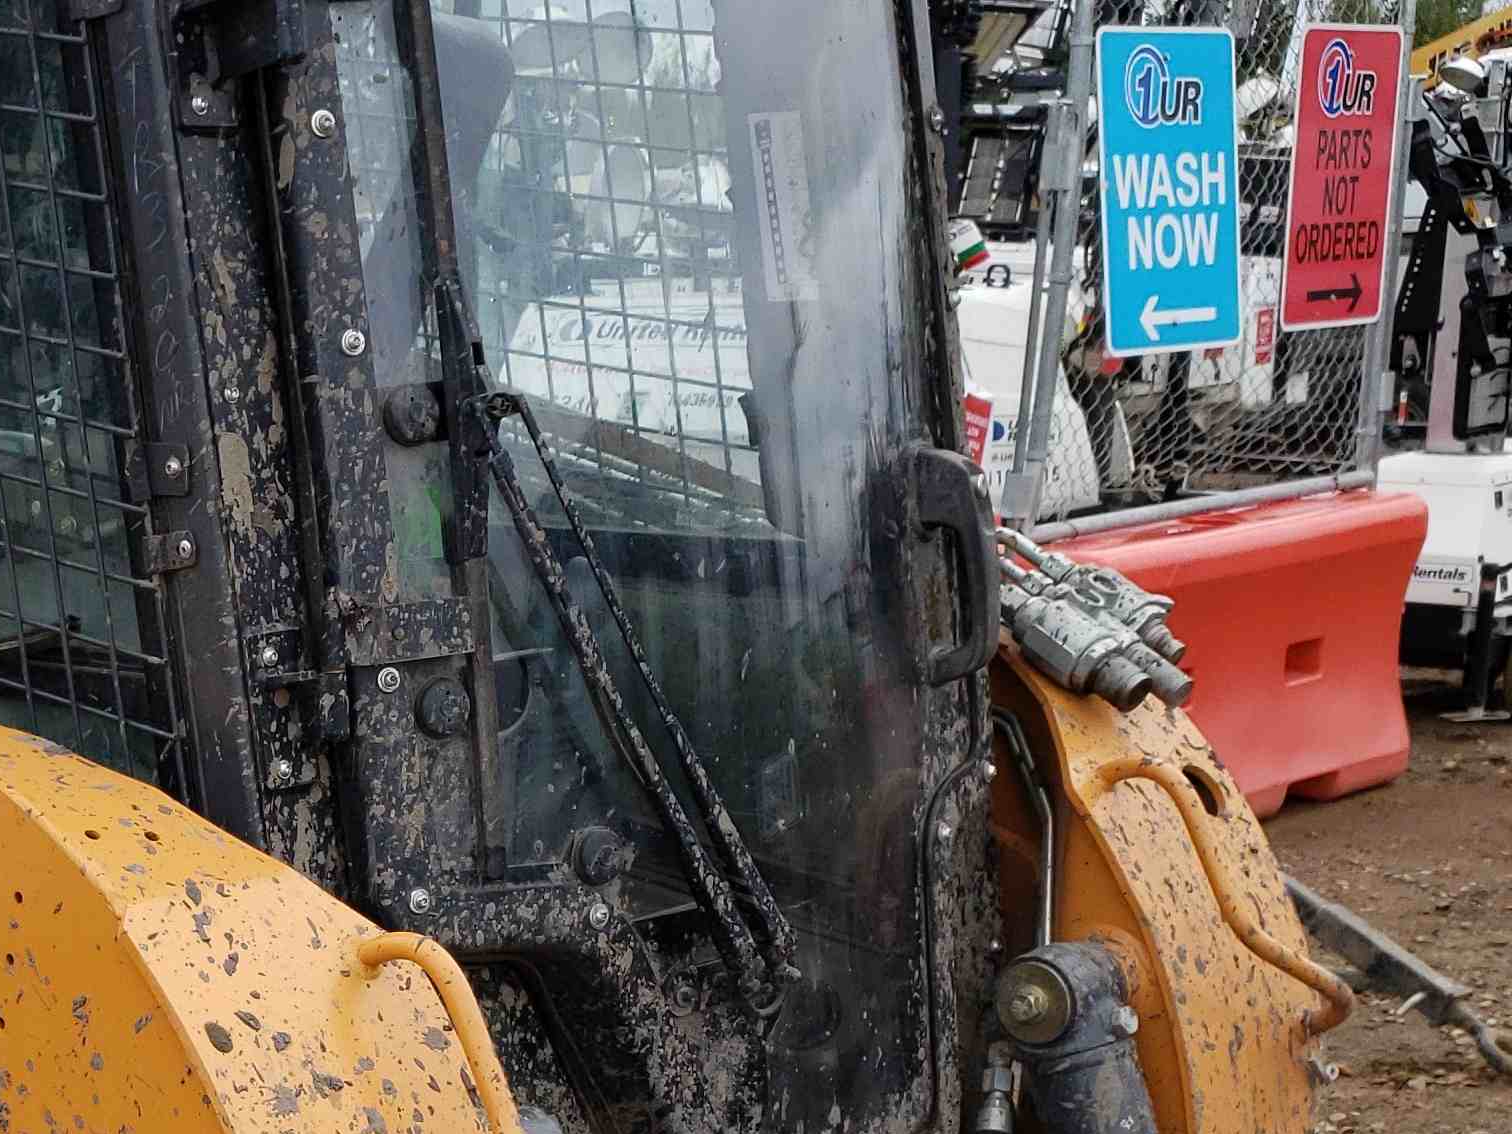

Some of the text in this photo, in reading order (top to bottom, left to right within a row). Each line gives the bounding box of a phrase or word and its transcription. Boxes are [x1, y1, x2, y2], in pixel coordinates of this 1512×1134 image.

[1316, 128, 1373, 171] PARTS
[1112, 151, 1226, 210] WASH
[1322, 175, 1360, 217] NOT
[1127, 211, 1219, 271] NOW
[1295, 220, 1380, 264] ORDERED
